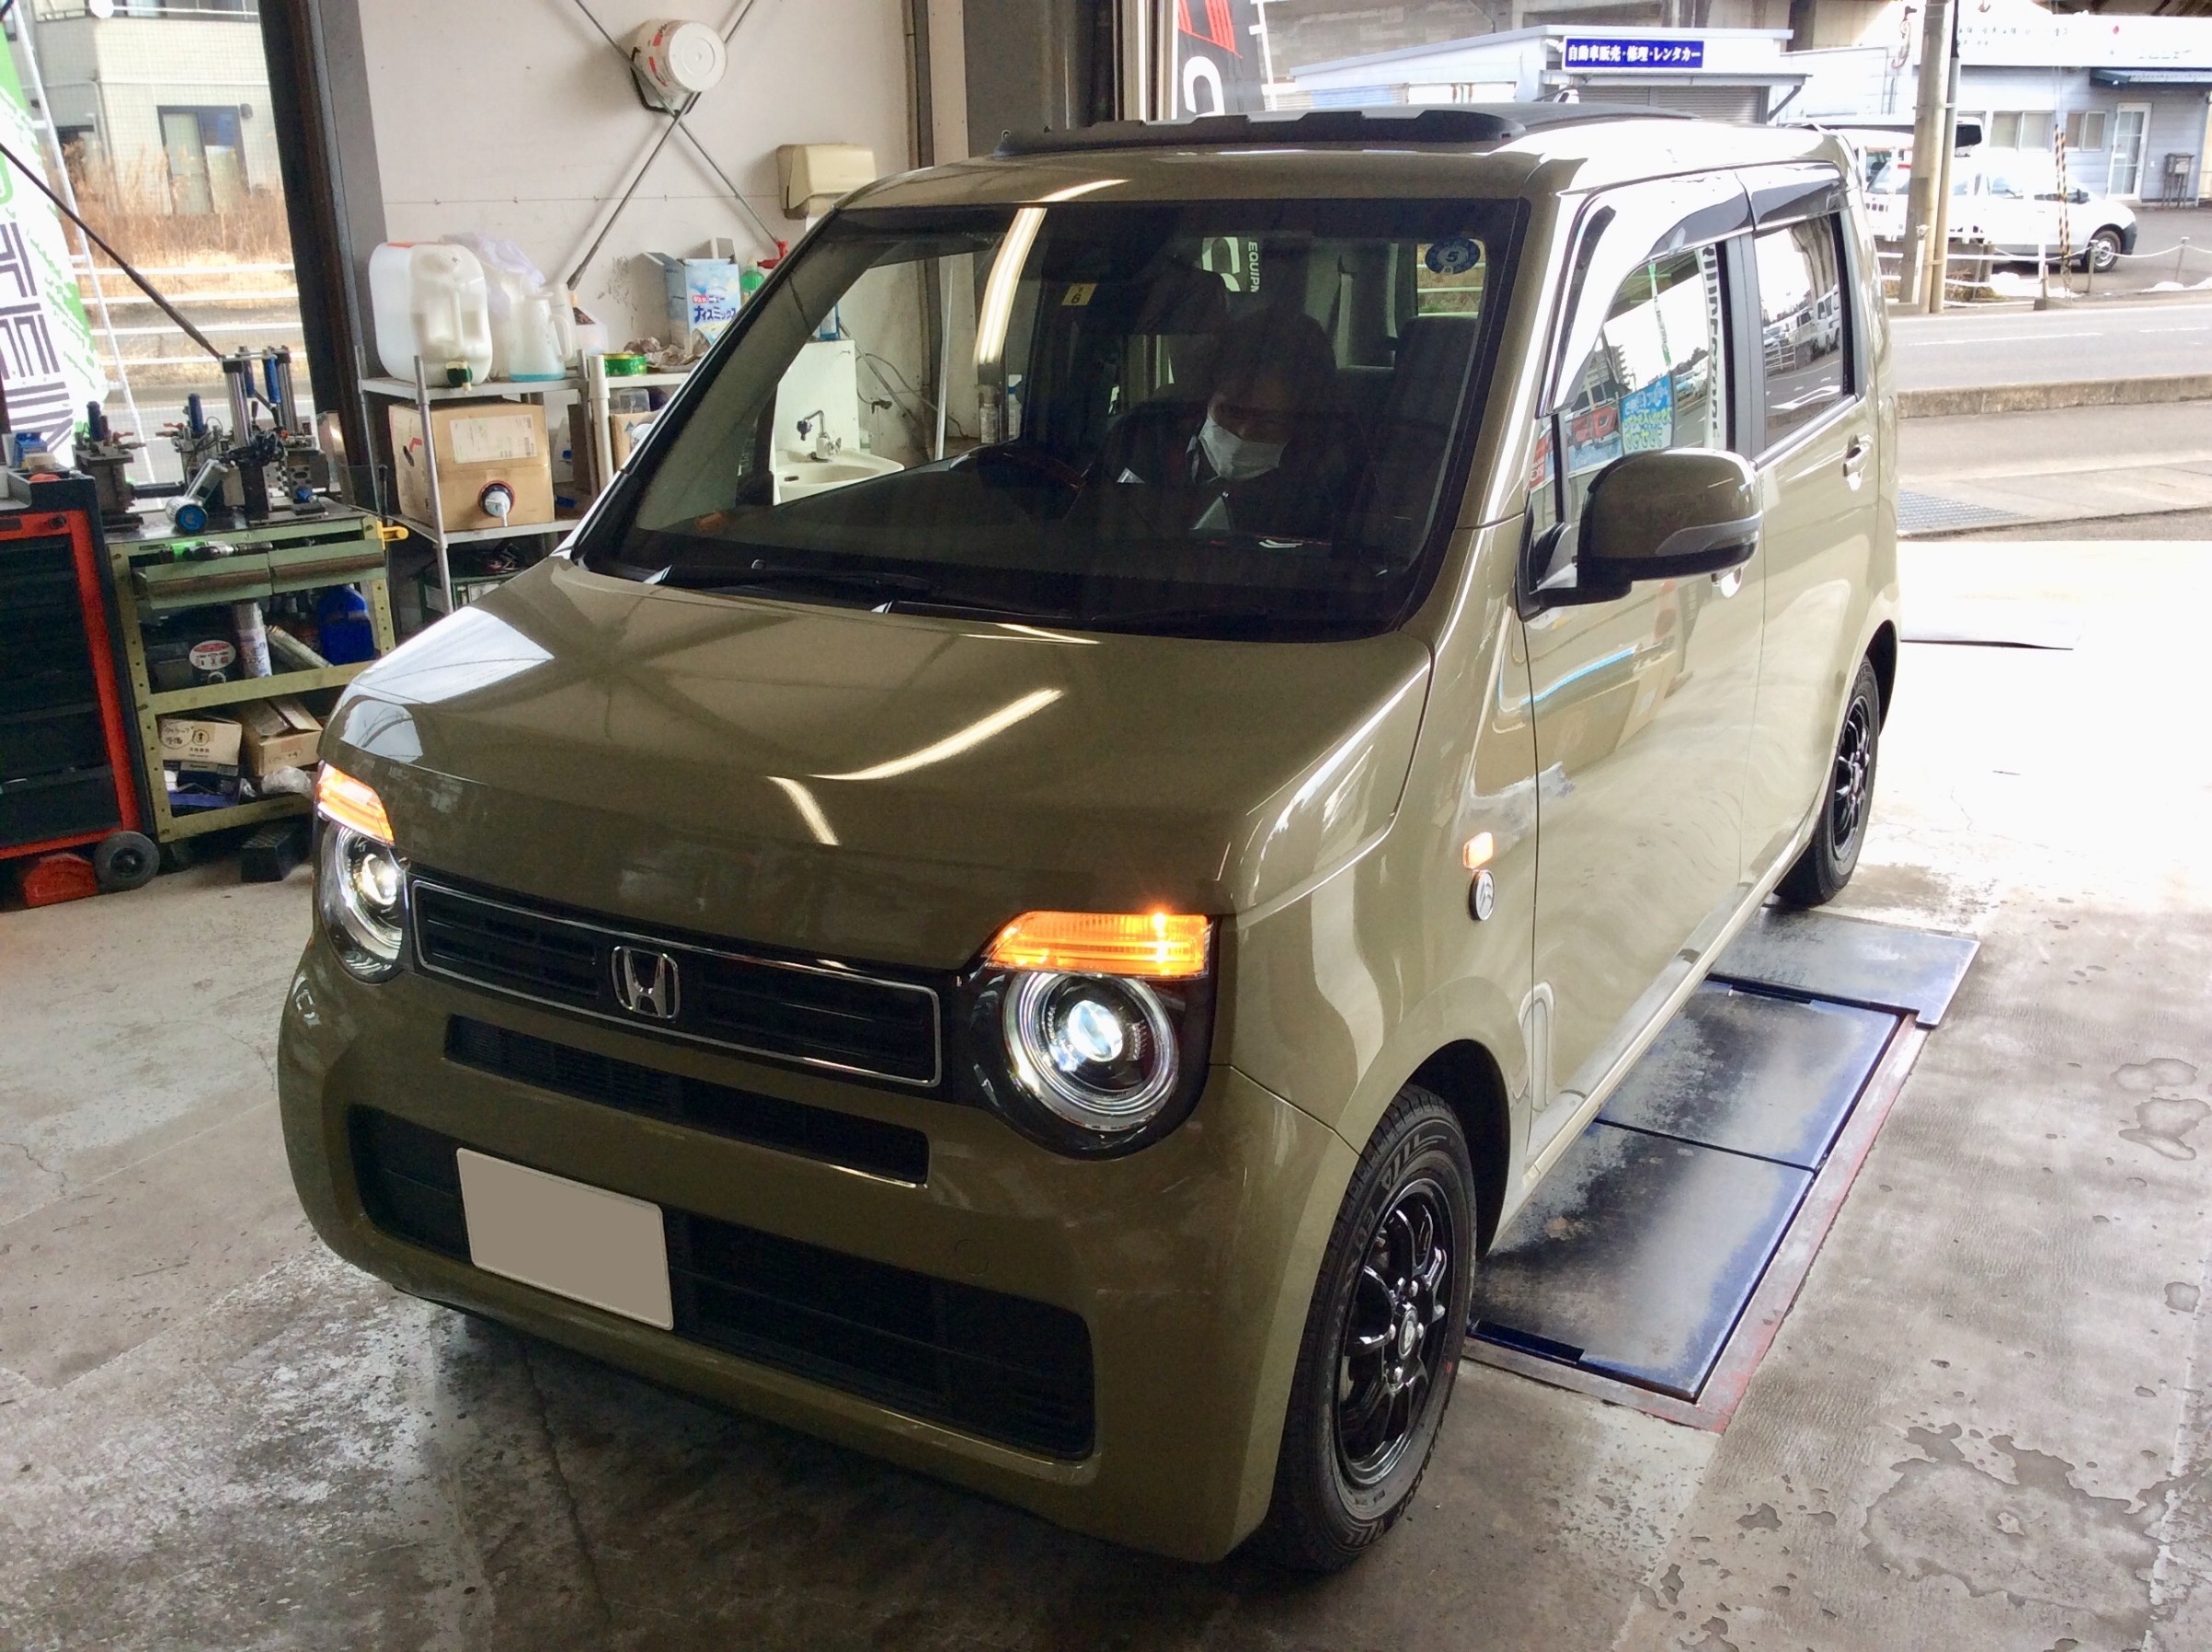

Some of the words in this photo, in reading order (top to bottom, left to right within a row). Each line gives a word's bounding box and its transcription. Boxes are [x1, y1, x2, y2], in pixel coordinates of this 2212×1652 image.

[1567, 44, 1702, 63] 自動車販売・修理・レンタカー
